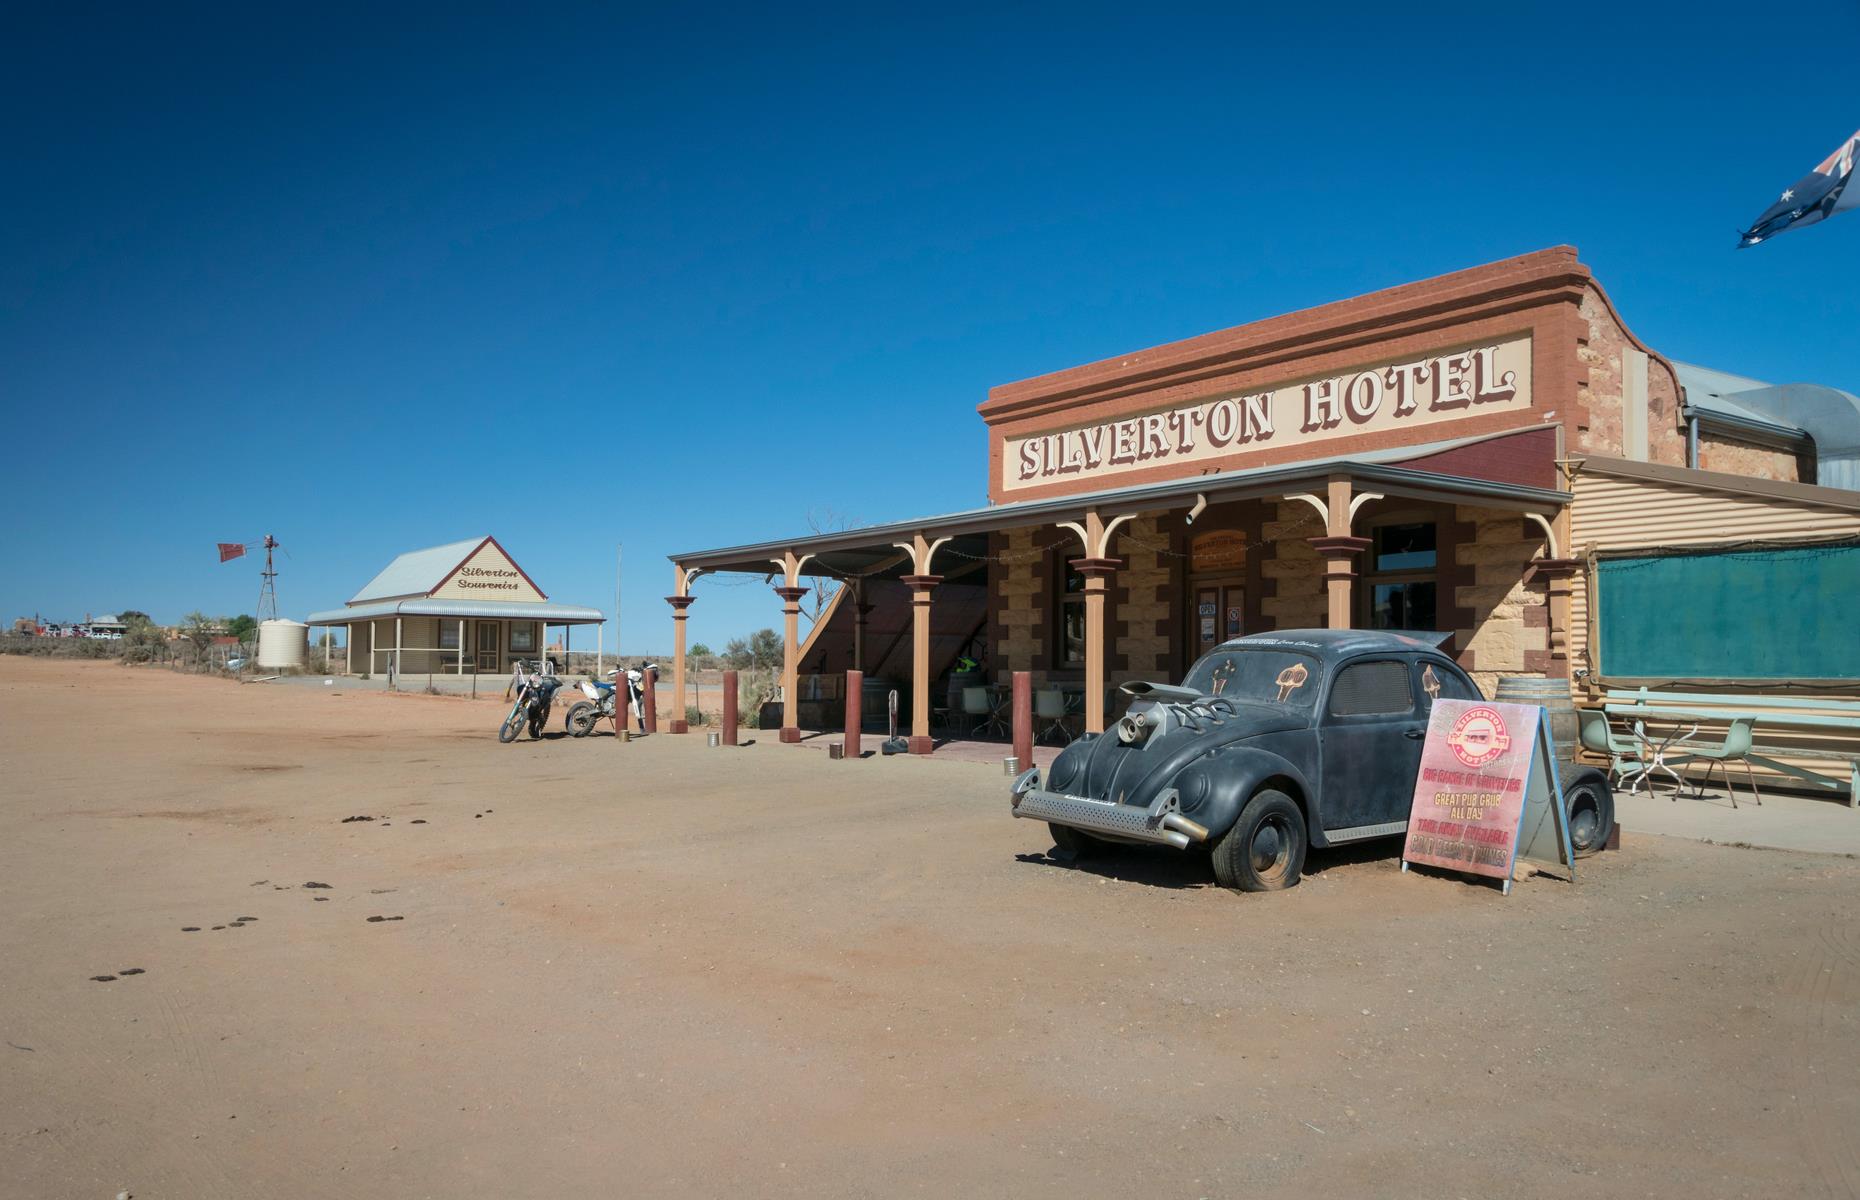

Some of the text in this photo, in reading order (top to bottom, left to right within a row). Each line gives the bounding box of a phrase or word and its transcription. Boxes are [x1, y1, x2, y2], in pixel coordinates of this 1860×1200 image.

[1018, 345, 1517, 480] SILVERTON HOTEL
[461, 567, 518, 577] Silverton
[457, 579, 519, 590] Souvenirs
[1200, 604, 1215, 614] OPEN
[1456, 711, 1503, 733] SILVERTON
[1460, 751, 1493, 764] HOTEL
[1423, 768, 1437, 782] BIG
[1437, 769, 1462, 785] RANGE
[1434, 792, 1501, 807] GREAT PUB GRUB
[1450, 807, 1483, 820] ALL DAY
[1417, 819, 1438, 834] TAKE
[1463, 825, 1509, 844] AVAILABLE
[1410, 834, 1434, 856] COLD
